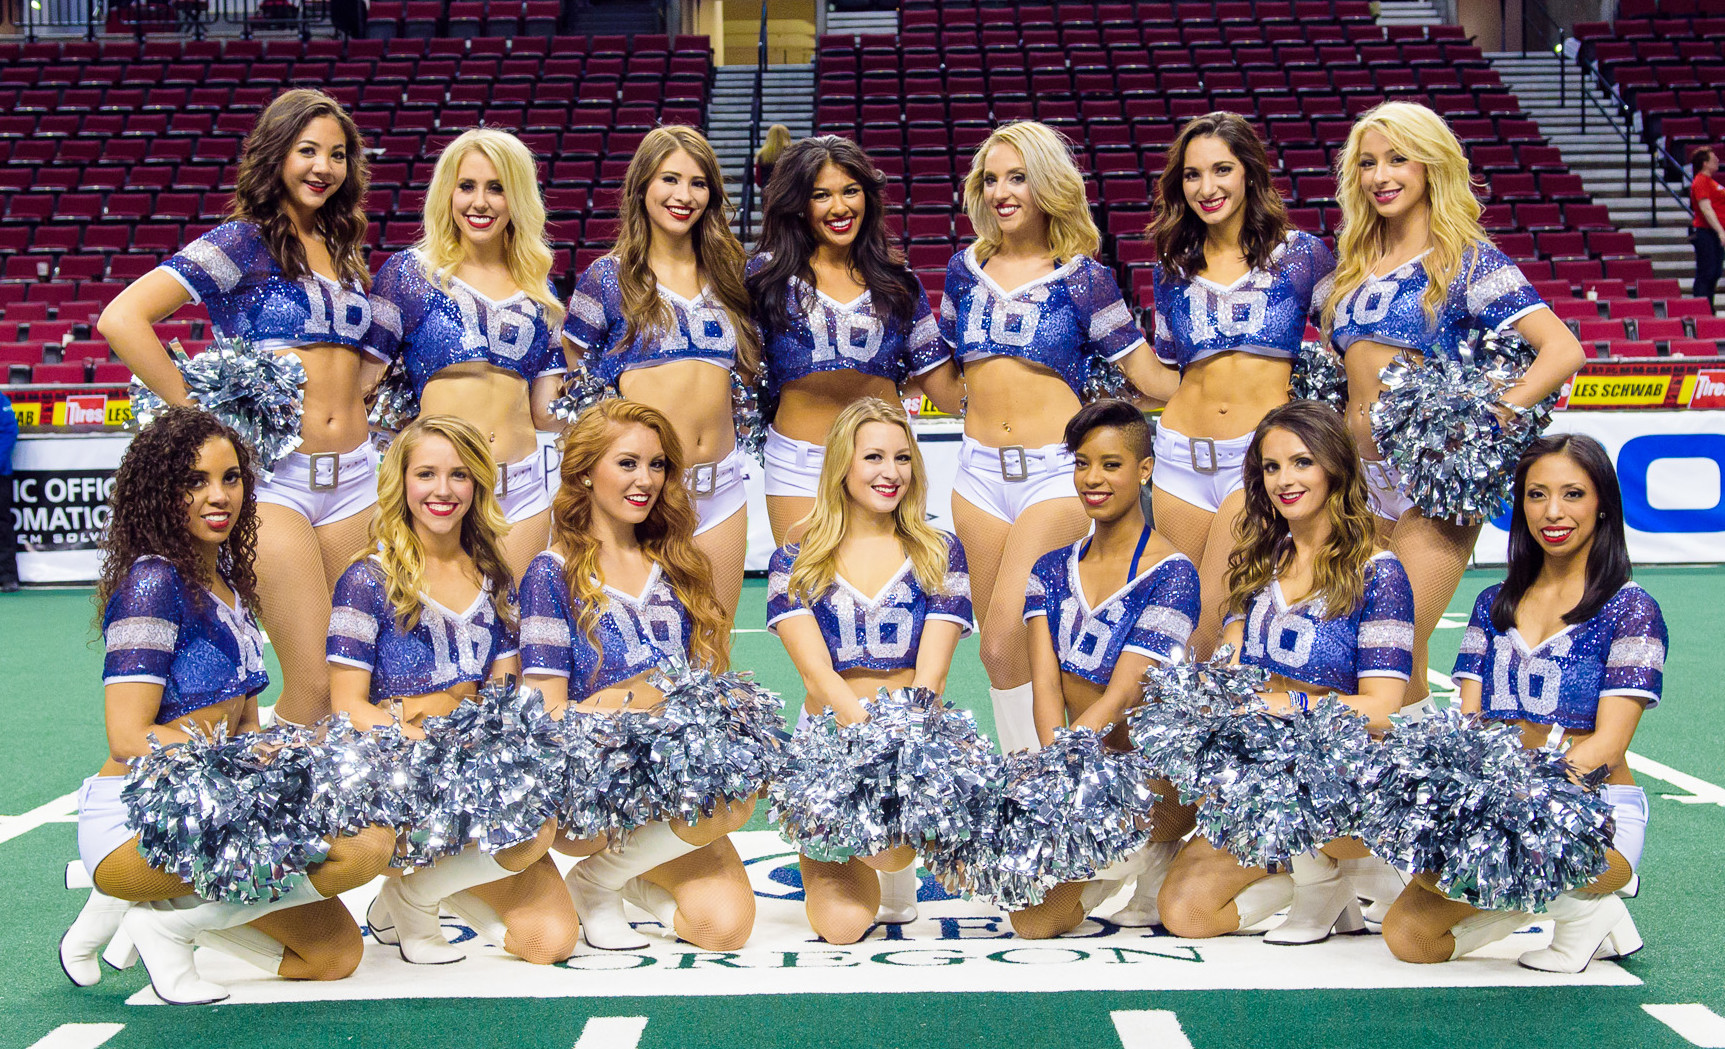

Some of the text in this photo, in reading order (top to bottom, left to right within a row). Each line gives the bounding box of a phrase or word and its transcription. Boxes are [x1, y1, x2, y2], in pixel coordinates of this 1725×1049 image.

[302, 277, 372, 341] 16
[453, 288, 538, 361] 16
[805, 298, 884, 363] 16
[961, 284, 1049, 347] 16
[1184, 271, 1273, 344] 16
[66, 401, 104, 425] Tires
[1574, 384, 1597, 397] LES
[1601, 383, 1664, 397] SCHWAB
[421, 599, 495, 686] 16
[609, 582, 685, 667] 16
[831, 581, 914, 662] 16
[1059, 598, 1127, 671] 16
[1244, 589, 1327, 668] 16
[1490, 633, 1573, 716] 16
[552, 945, 1206, 970] OREGON
